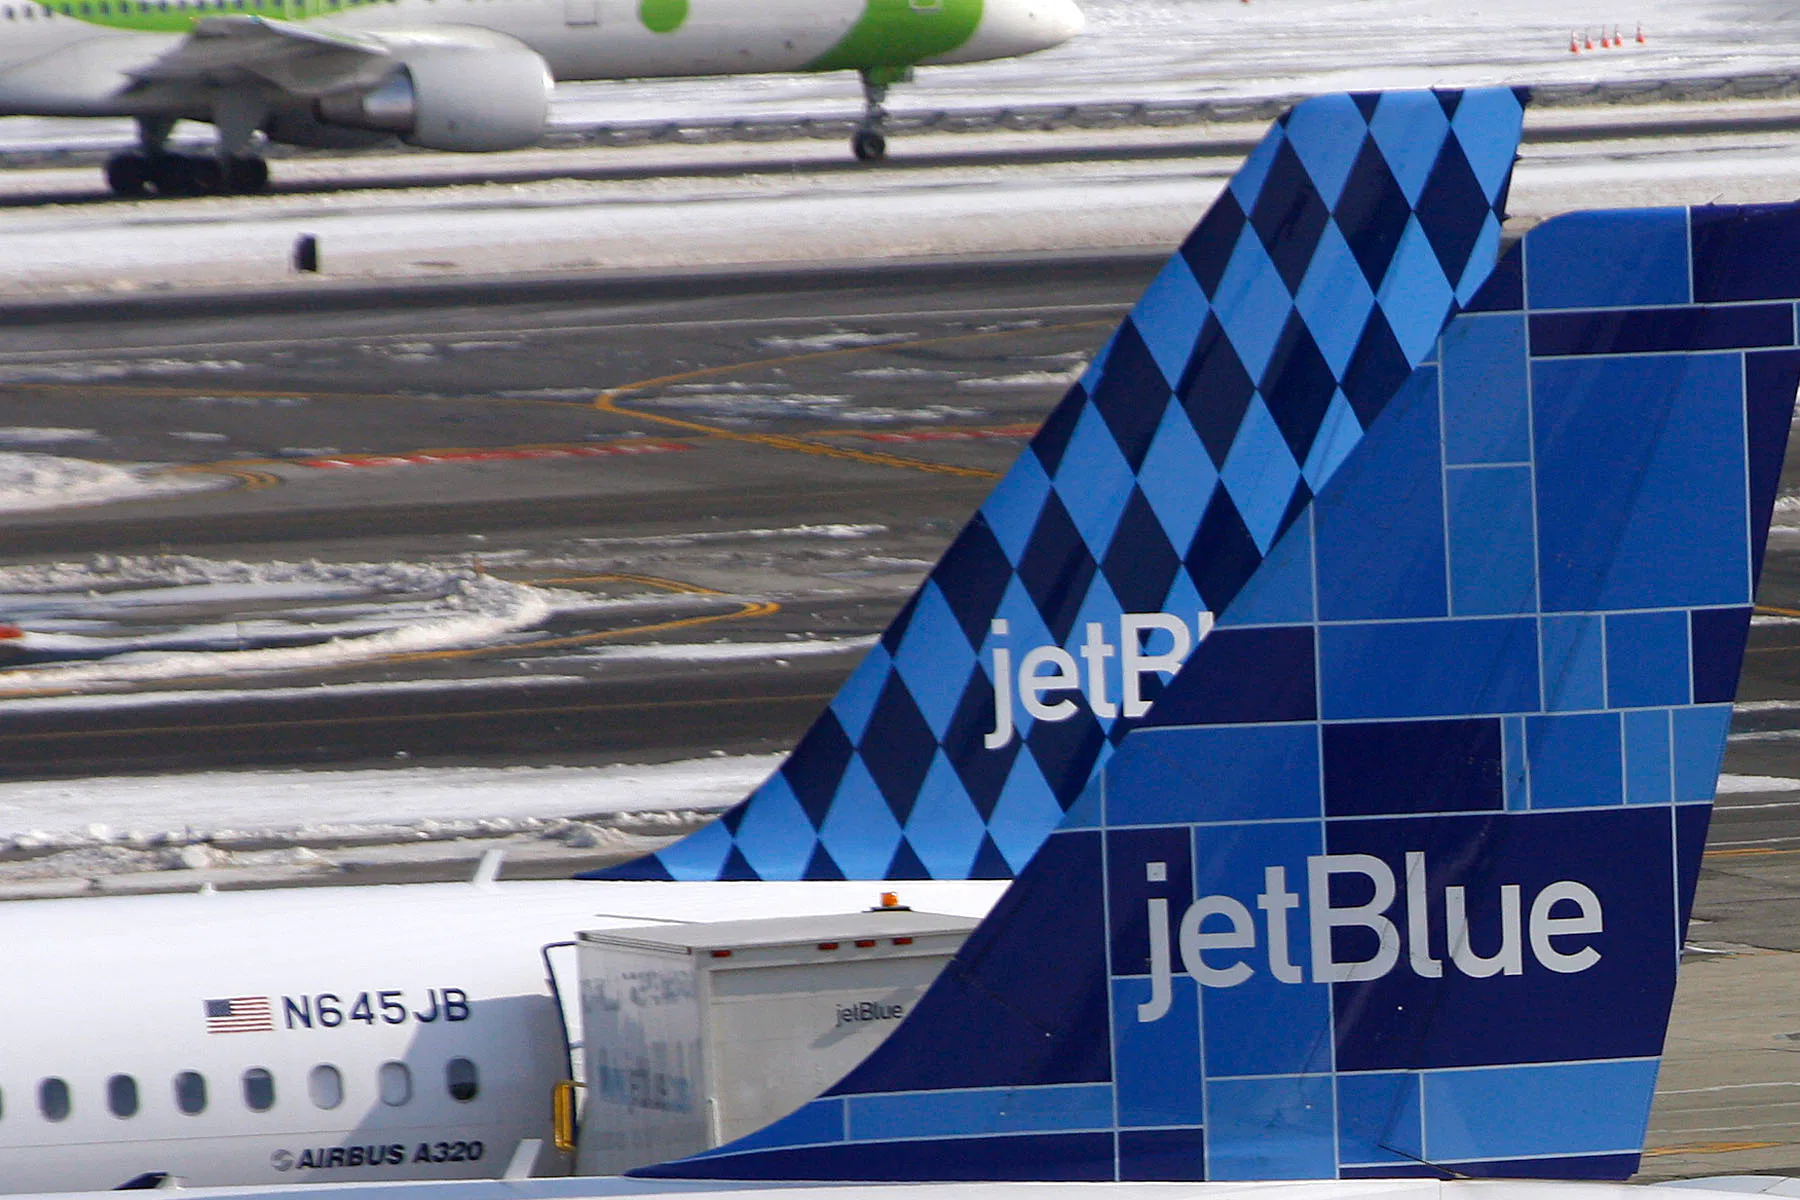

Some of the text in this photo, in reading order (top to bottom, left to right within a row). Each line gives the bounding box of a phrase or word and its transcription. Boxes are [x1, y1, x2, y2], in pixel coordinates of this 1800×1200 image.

[1137, 850, 1604, 1023] jetBlue
[281, 987, 471, 1030] N645JB
[836, 1001, 904, 1029] jetBlue
[296, 1140, 484, 1169] AIRBUS A320
